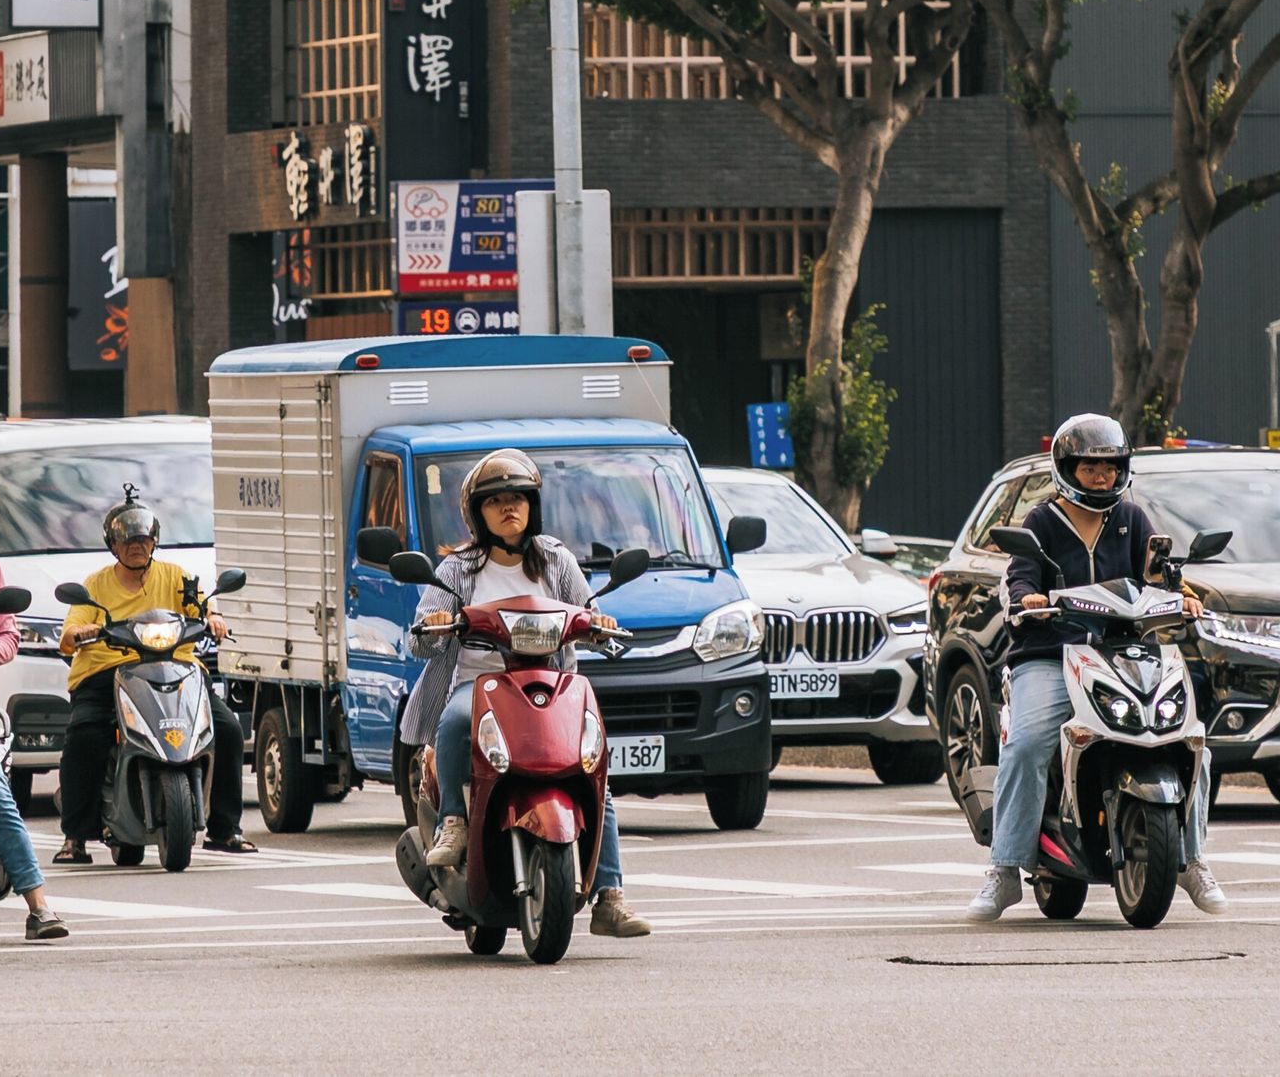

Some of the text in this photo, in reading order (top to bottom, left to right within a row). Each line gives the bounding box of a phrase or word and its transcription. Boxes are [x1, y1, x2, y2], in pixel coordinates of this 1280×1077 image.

[476, 199, 500, 213] 80
[478, 236, 502, 251] 90
[421, 309, 450, 333] 19
[770, 673, 837, 693] BTN-5899
